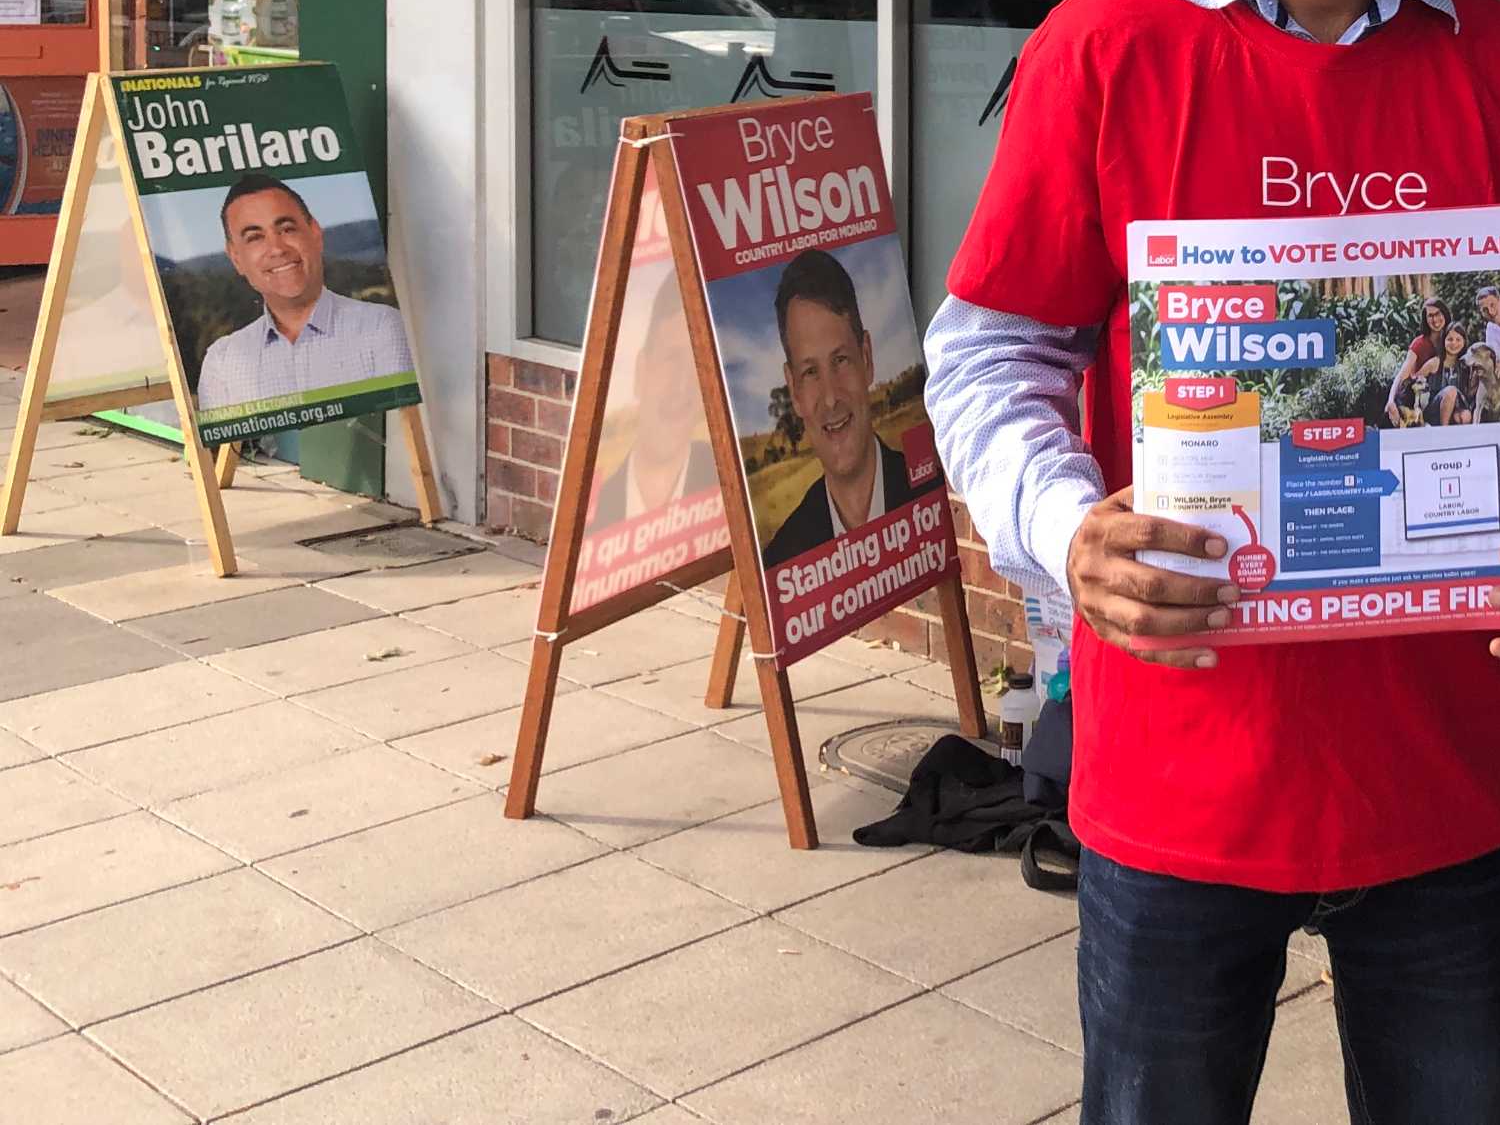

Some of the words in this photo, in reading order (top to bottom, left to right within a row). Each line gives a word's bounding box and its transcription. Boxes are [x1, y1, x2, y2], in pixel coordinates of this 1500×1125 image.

[124, 76, 201, 92] NATIONALS
[127, 94, 210, 131] John
[132, 123, 341, 179] Barilaro
[737, 116, 834, 165] Bryce
[1262, 156, 1428, 216] Bryce
[696, 165, 880, 251] Wilson
[735, 241, 784, 264] COUNTRY
[784, 233, 819, 253] LABOR
[819, 228, 841, 243] FOR
[839, 219, 878, 238] MONARO
[1182, 246, 1235, 264] How
[1241, 246, 1266, 264] to
[1269, 243, 1336, 263] VOTE
[1343, 237, 1462, 261] COUNTRY
[1149, 255, 1175, 265] Labor
[1167, 292, 1265, 324] Bryce
[1166, 325, 1324, 362] Wilson
[1177, 385, 1215, 398] STEP
[203, 402, 344, 442] nswnationals.org.au
[1303, 427, 1342, 441] STEP
[1345, 426, 1355, 439] 2
[1181, 439, 1219, 448] MONARO
[908, 460, 936, 481] Labor
[1431, 459, 1463, 471] Group
[1466, 458, 1472, 468] J
[1304, 507, 1326, 516] THEN
[1424, 510, 1455, 519] COUNTRY
[1457, 508, 1480, 516] LABOR
[776, 532, 881, 604] Standing
[883, 519, 911, 552] up
[912, 501, 942, 537] for
[785, 602, 828, 645] our
[831, 539, 947, 621] community
[1240, 598, 1312, 624] TING
[1321, 588, 1440, 620] PEOPLE
